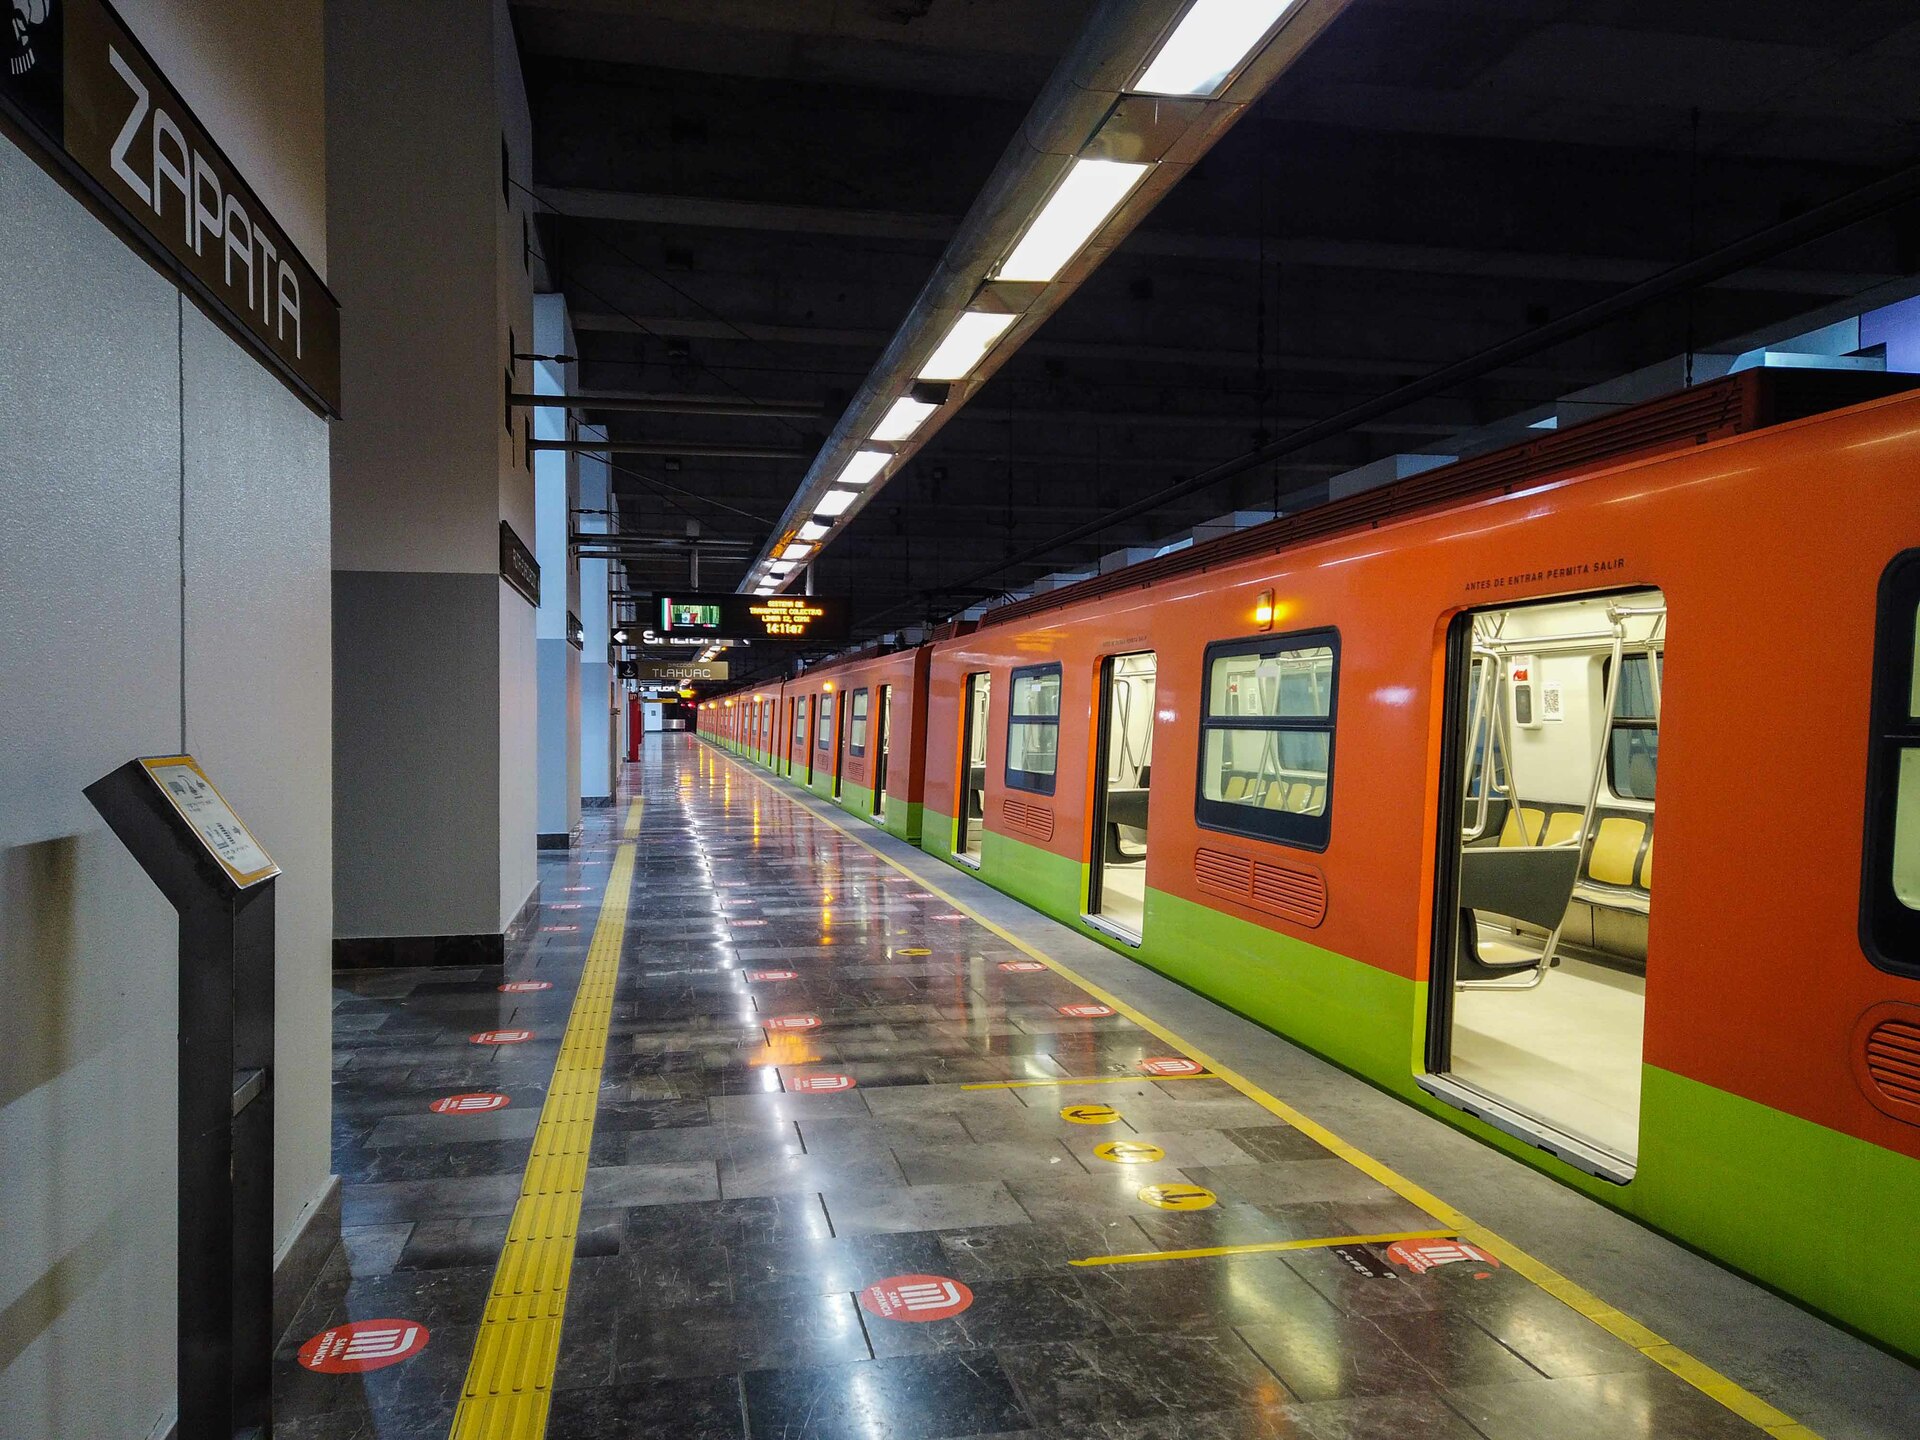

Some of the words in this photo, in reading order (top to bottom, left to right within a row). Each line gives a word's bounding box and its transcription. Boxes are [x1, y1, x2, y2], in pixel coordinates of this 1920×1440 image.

[109, 44, 301, 360] ZAPATA
[1465, 581, 1491, 591] ANTES
[1494, 578, 1506, 588] DE
[1508, 572, 1543, 585] ENTRAR
[1546, 564, 1589, 579] PERMITA
[1593, 558, 1625, 573] SALIR
[652, 668, 711, 678] TLAHUAC
[310, 1331, 337, 1367] DISTANCIA
